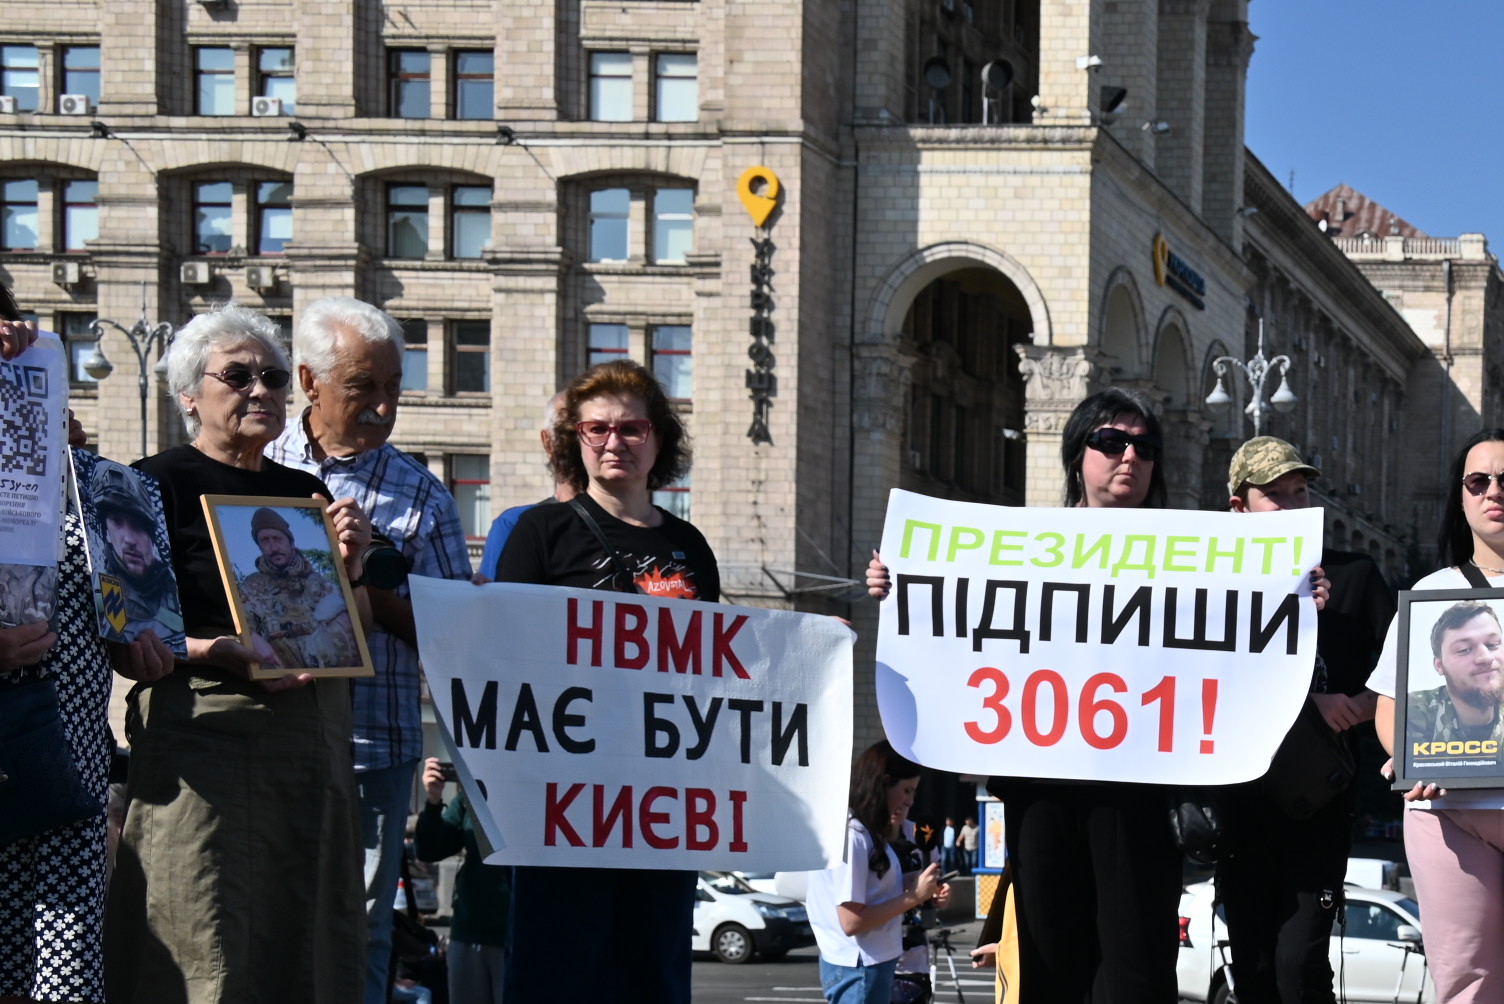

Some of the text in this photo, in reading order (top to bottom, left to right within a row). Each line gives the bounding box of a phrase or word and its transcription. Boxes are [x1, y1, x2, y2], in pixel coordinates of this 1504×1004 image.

[899, 519, 1304, 579] ПРЕЗИДЕНТ!
[566, 597, 751, 680] НВМК
[896, 573, 1300, 655] ПІДПИШИ
[450, 677, 809, 767] МАЄ БУТИ
[963, 666, 1219, 754] 3061!
[1413, 740, 1498, 756] КРОСС
[544, 782, 748, 853] КИЄВІ
